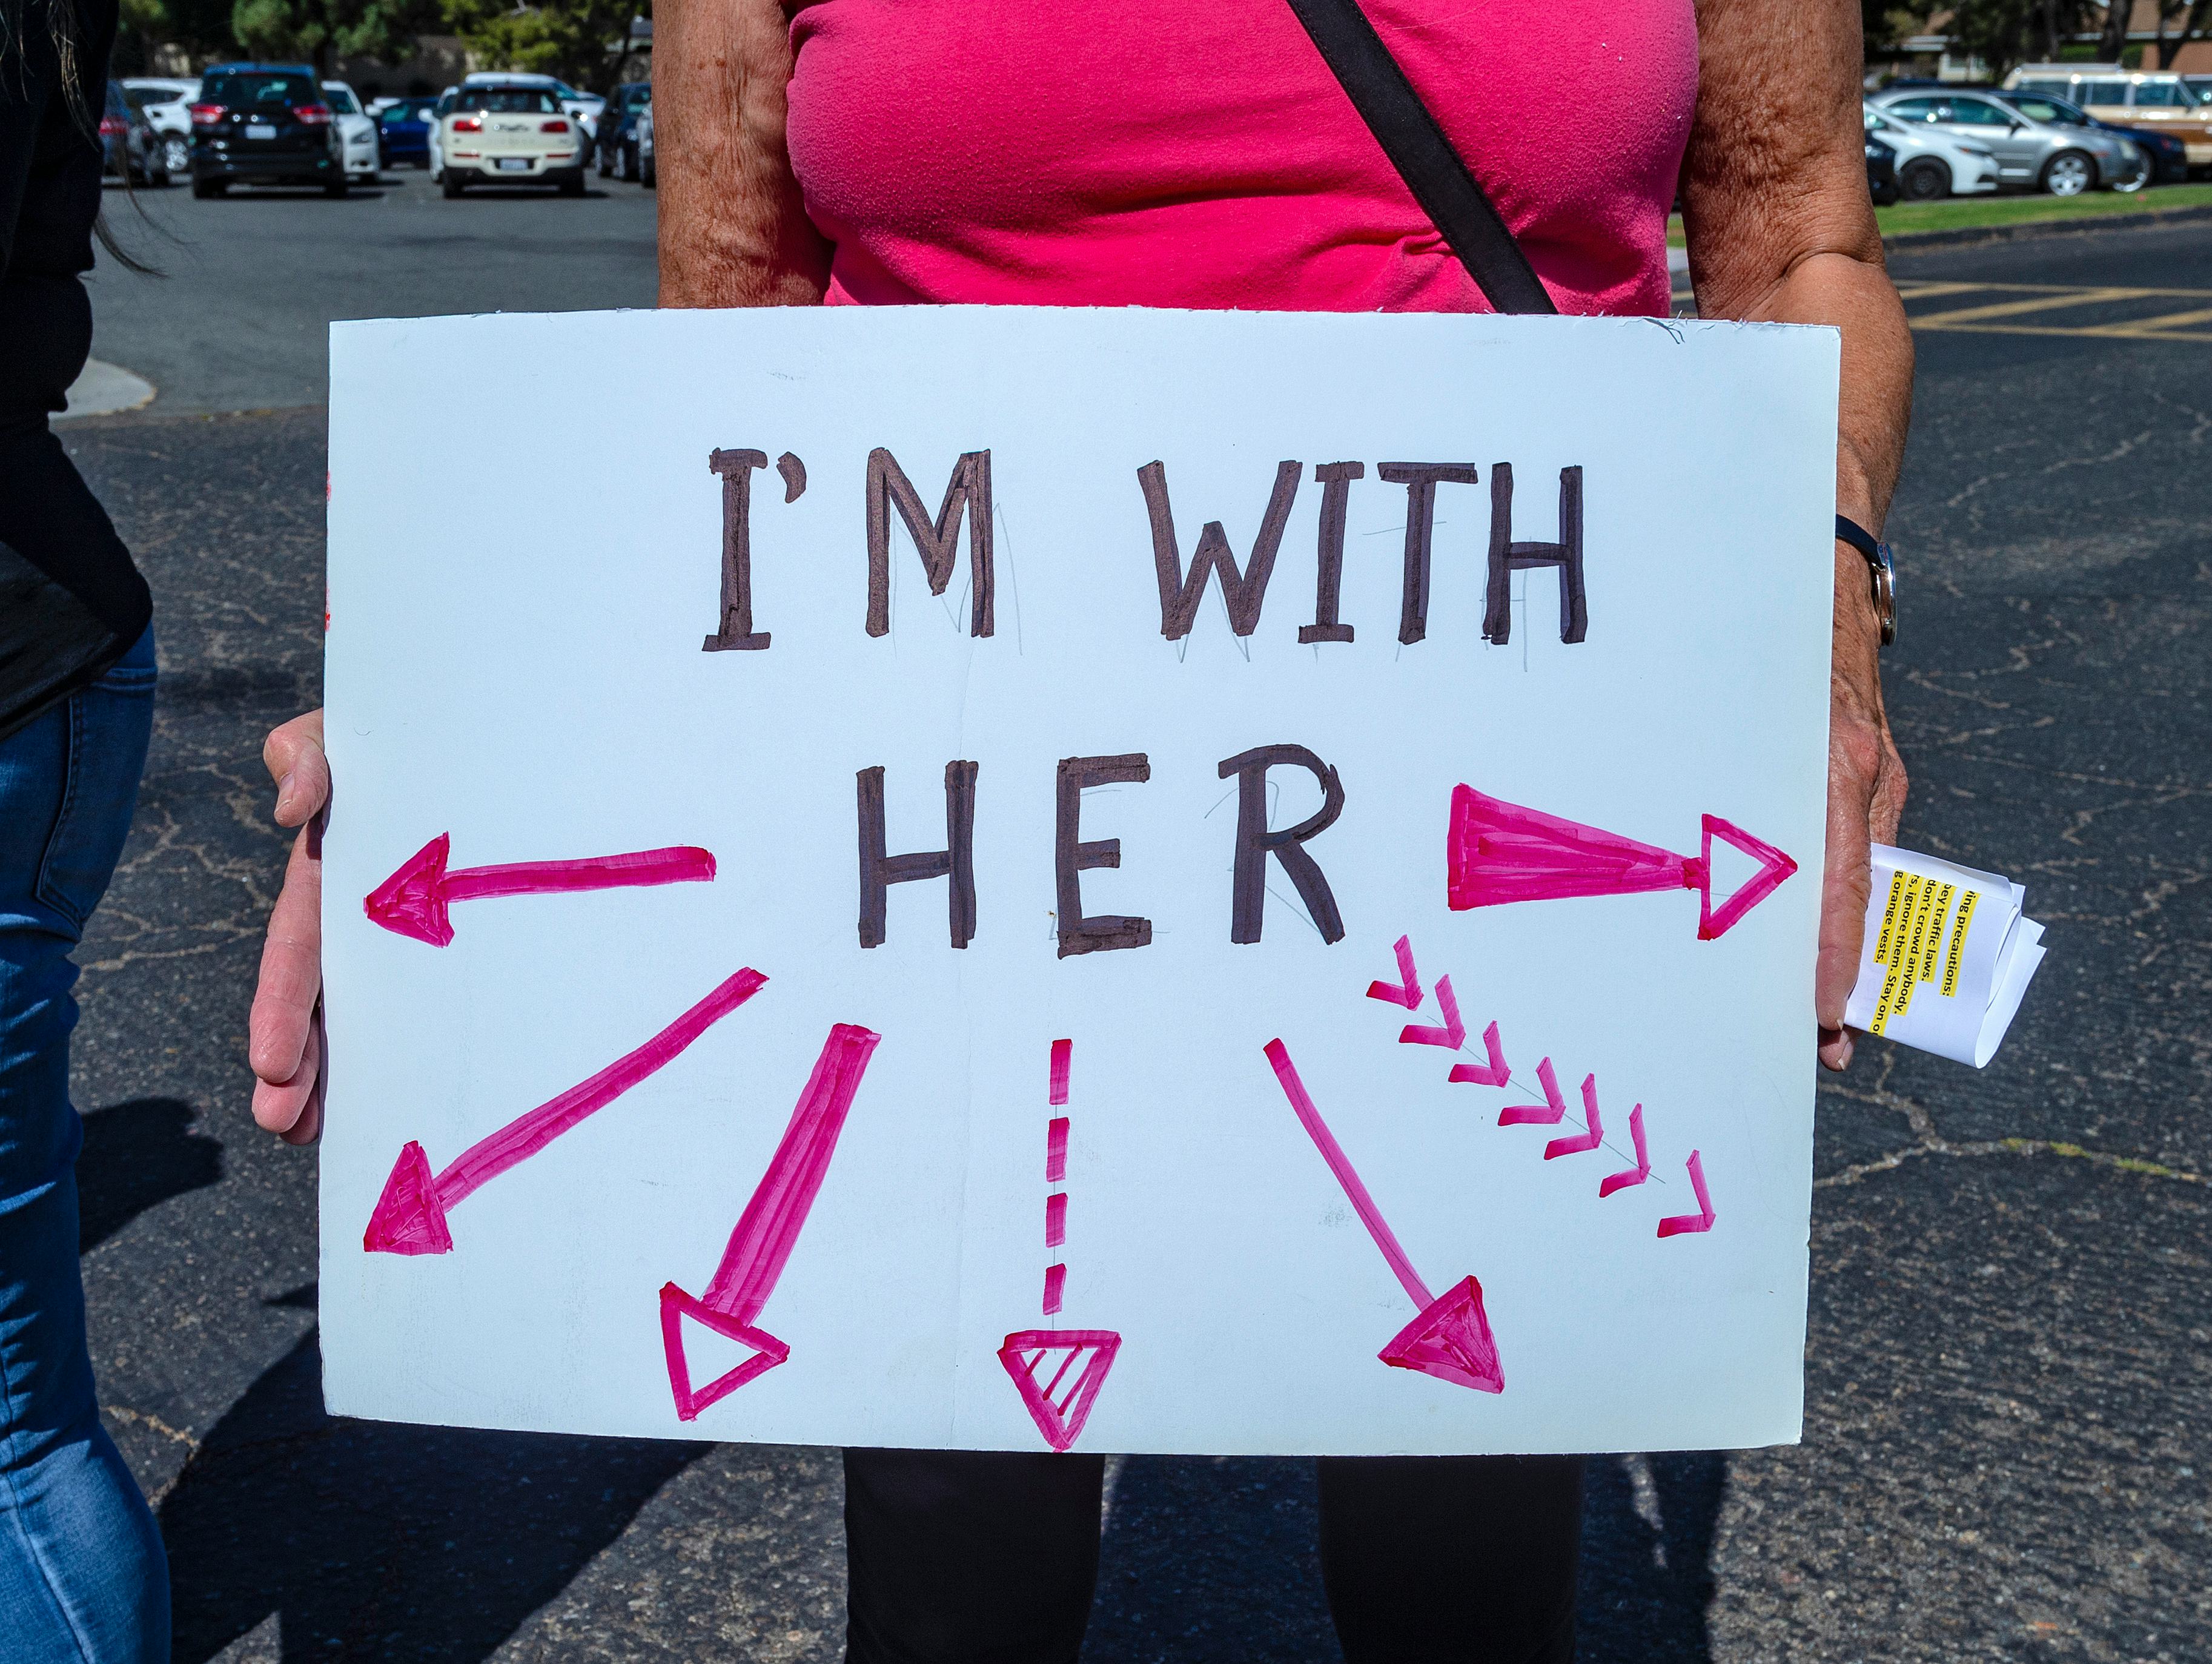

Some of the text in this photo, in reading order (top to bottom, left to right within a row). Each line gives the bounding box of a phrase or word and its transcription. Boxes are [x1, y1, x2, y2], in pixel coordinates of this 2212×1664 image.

[702, 447, 1588, 652] I'M WITH
[856, 744, 1345, 960] HER
[1885, 882, 1901, 925] orange
[1899, 891, 1916, 931] ignore
[1875, 928, 1890, 963] vests.
[1894, 879, 1936, 1014] don't crowd anybody.
[1929, 908, 1945, 946] traffic
[1890, 935, 1906, 971] them.
[1921, 949, 1936, 981] laws.
[1942, 916, 1966, 997] precautions:
[1880, 975, 1897, 1003] Stay
[1876, 1005, 1886, 1020] on
